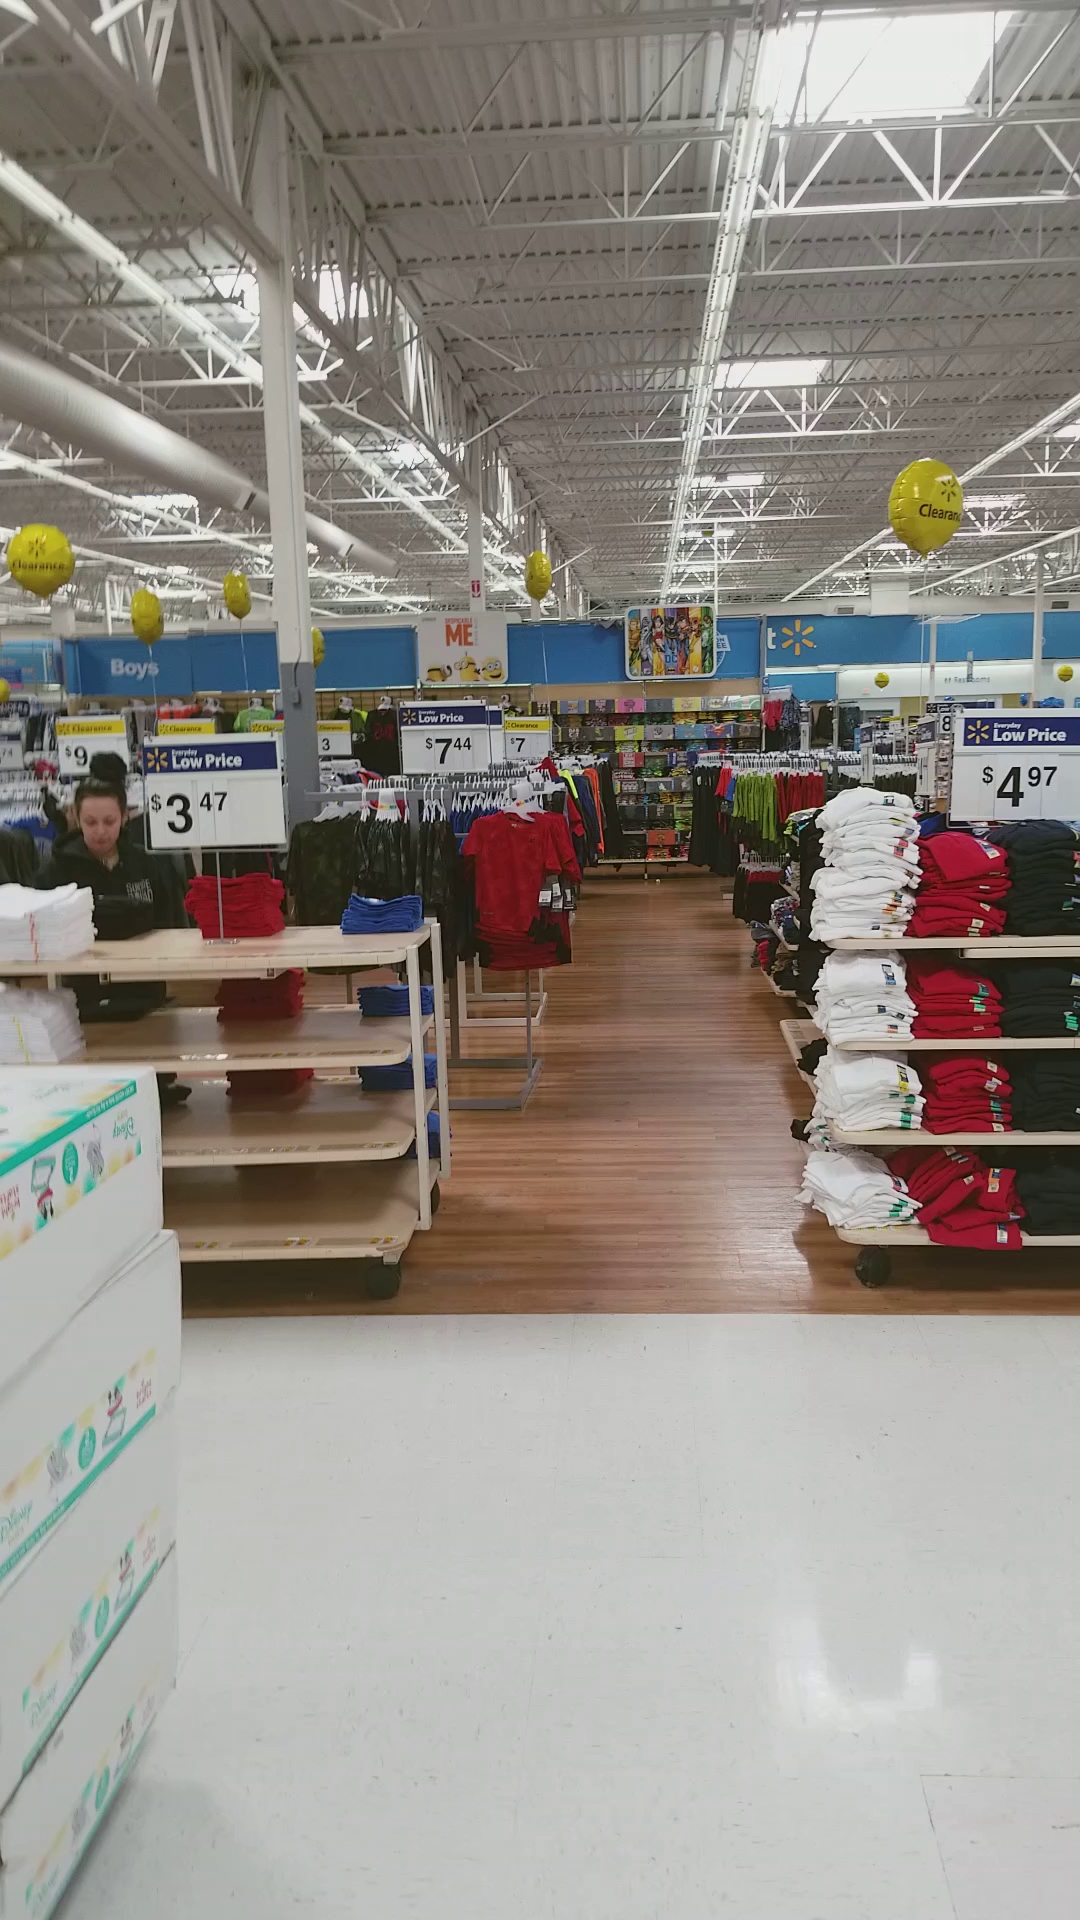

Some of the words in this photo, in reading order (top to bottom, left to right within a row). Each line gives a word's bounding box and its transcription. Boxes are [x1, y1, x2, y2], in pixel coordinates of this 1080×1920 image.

[11, 559, 65, 571] Clearance
[445, 624, 473, 647] ME
[665, 654, 678, 664] DC
[110, 658, 159, 681] Boys
[418, 714, 438, 723] Low
[439, 713, 464, 723] Price
[71, 723, 113, 733] Clearance
[993, 722, 1022, 730] Everyday
[992, 727, 1026, 742] Low
[1028, 725, 1067, 742] Price
[171, 748, 198, 758] Everyday
[172, 755, 203, 770] Low
[205, 753, 242, 768] Price
